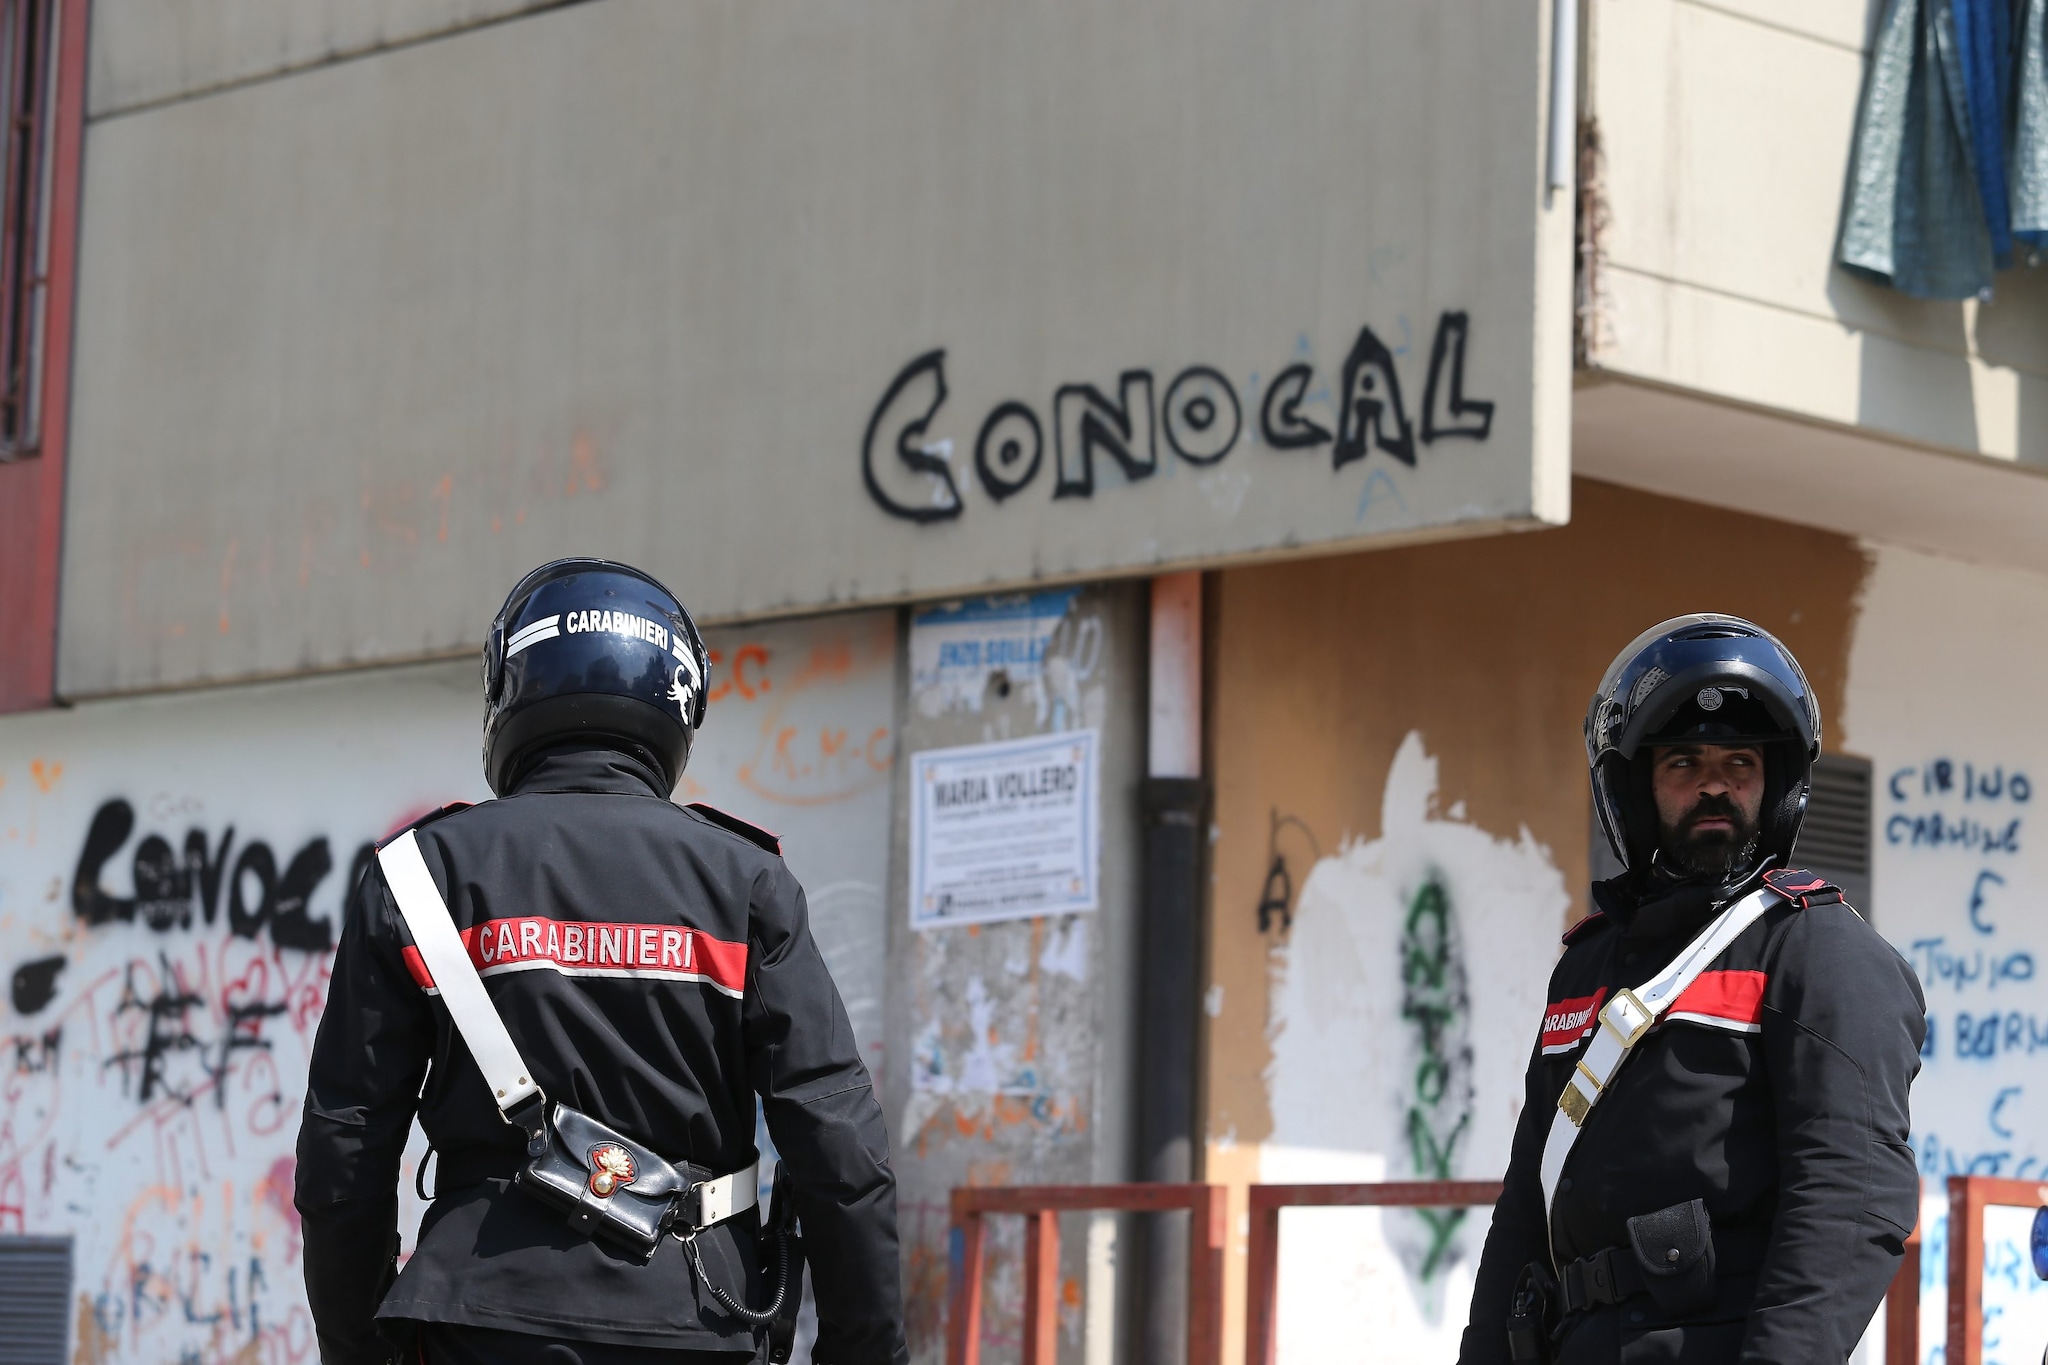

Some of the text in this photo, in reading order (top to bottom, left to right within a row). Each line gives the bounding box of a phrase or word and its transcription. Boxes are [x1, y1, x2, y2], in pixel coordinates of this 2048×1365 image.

[862, 311, 1494, 523] CONOCAL
[566, 609, 668, 650] CARABINIERI
[935, 765, 1077, 807] MARIA VOLLERO
[1888, 760, 2032, 801] CIRINO
[479, 920, 694, 968] CARABINIERI
[1908, 936, 2034, 994] TONIO
